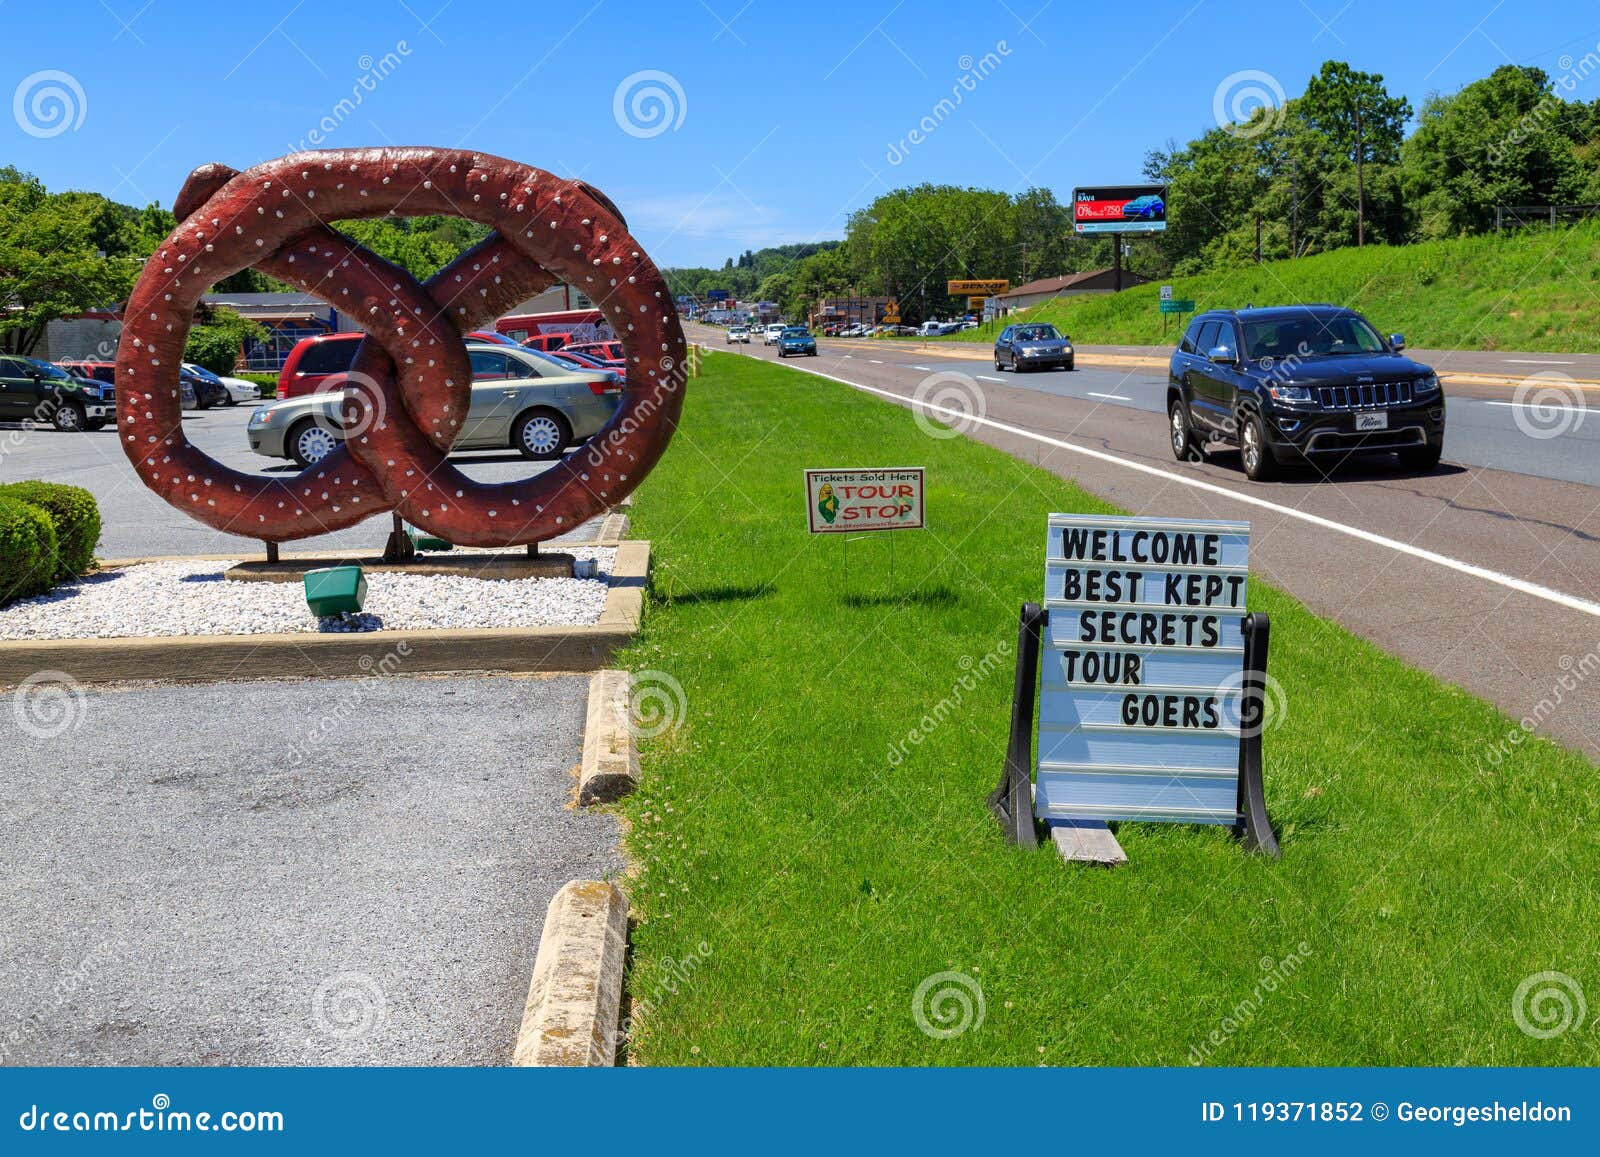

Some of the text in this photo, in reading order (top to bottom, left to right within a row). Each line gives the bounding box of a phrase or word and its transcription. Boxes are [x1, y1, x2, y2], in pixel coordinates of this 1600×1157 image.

[813, 473, 919, 482] Tickets Sold Here
[838, 484, 914, 500] TOUR
[842, 504, 913, 520] STOP
[1062, 528, 1219, 566] WELCOME
[1064, 568, 1244, 607] BEST KEPT
[1080, 610, 1219, 647] SECRETS
[1063, 650, 1141, 685] TOUR
[1122, 693, 1219, 729] GOERS
